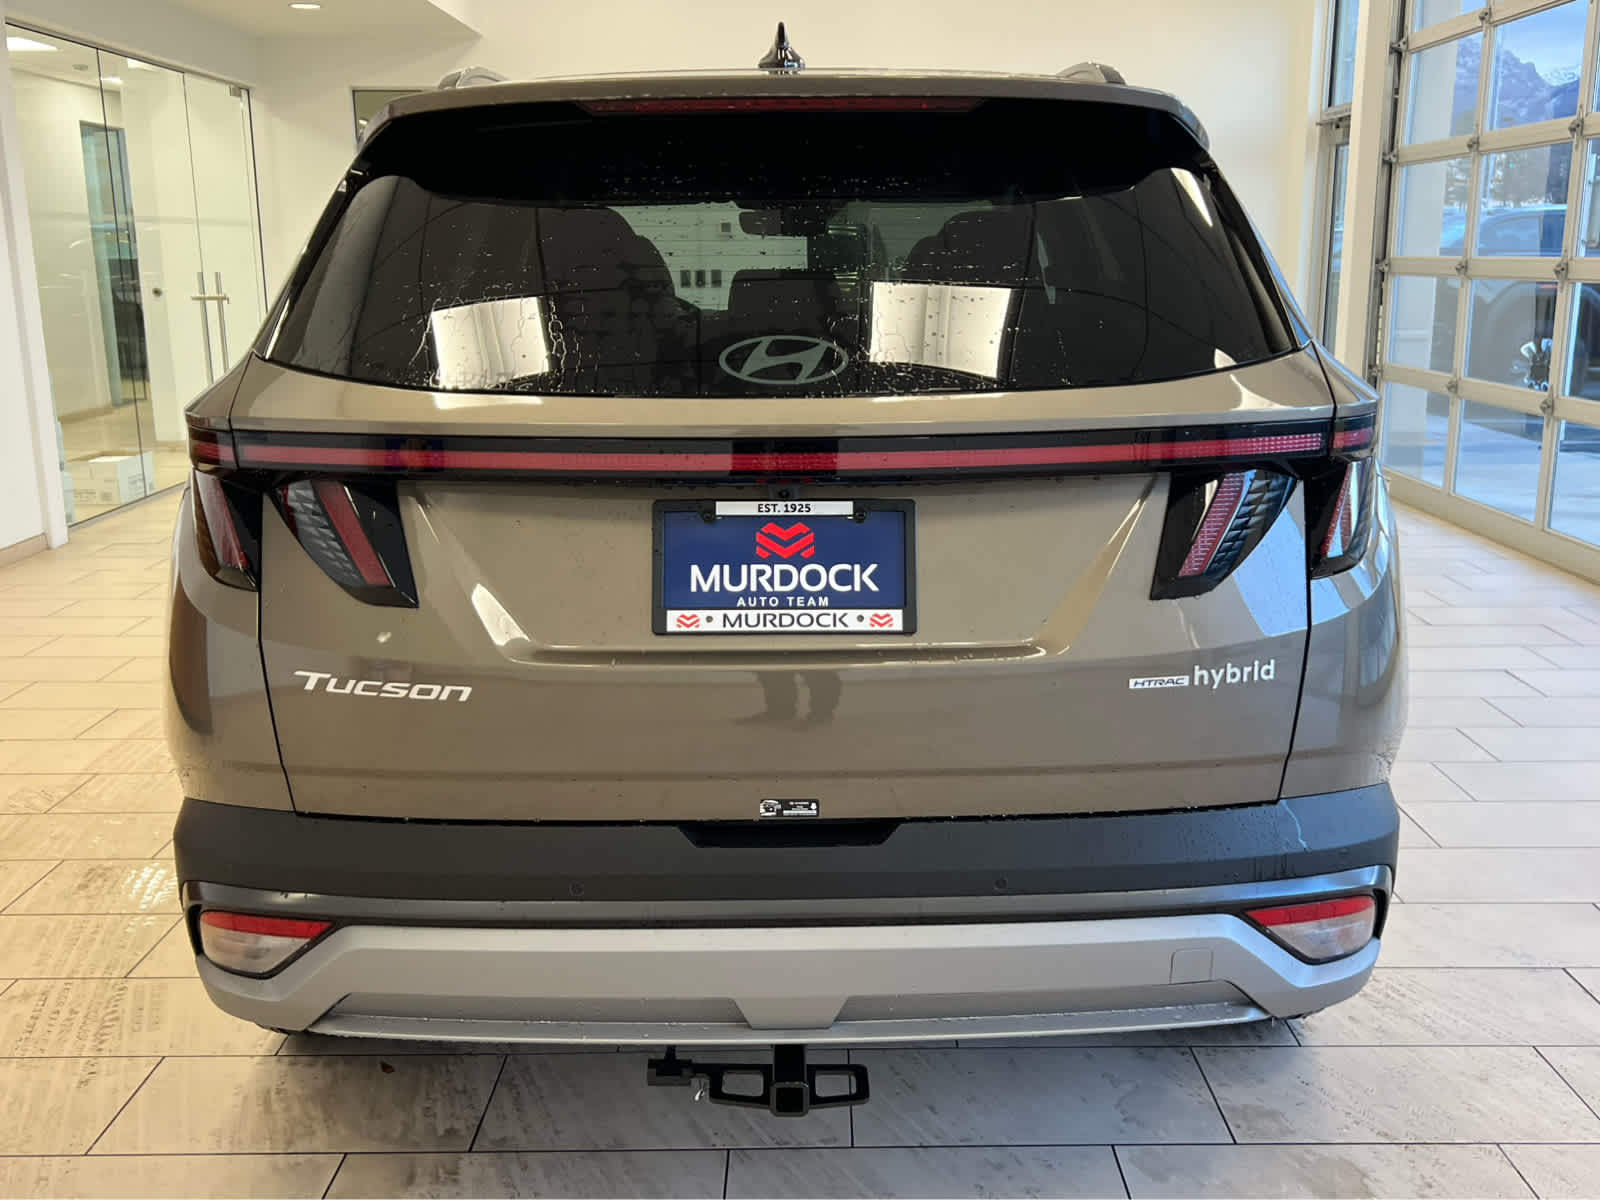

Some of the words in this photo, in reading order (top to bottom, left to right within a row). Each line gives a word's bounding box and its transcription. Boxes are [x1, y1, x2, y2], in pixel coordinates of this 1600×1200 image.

[757, 503, 782, 513] EST.
[784, 503, 812, 513] 1925
[690, 563, 880, 593] MURDOCK
[736, 596, 779, 607] AUTO
[786, 596, 829, 607] TEAM
[722, 612, 849, 628] MURDOCK
[1133, 677, 1185, 688] HTRAC
[1193, 659, 1275, 689] hybrid
